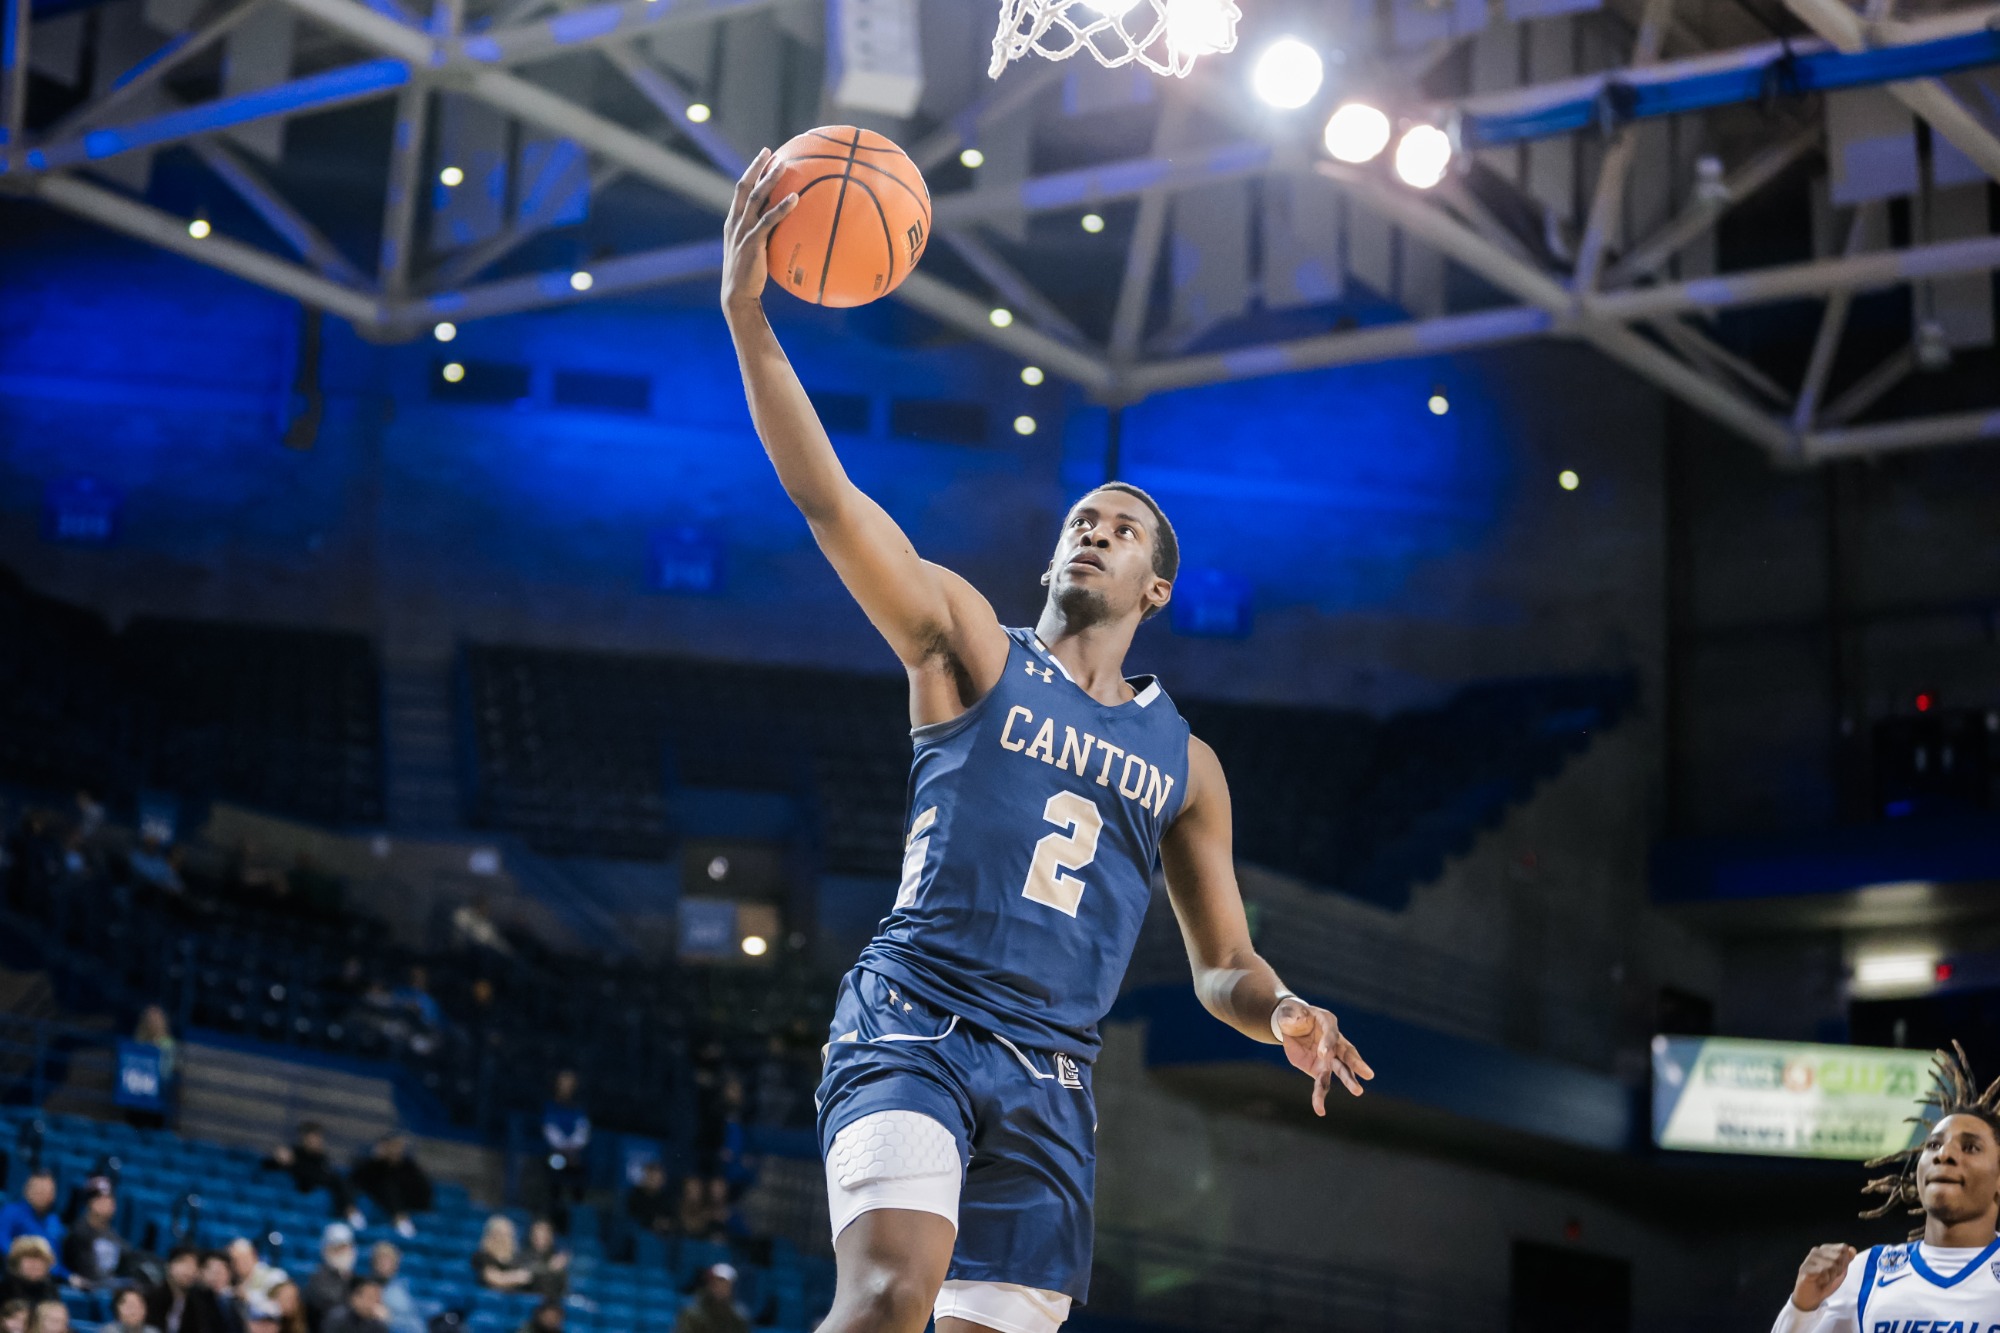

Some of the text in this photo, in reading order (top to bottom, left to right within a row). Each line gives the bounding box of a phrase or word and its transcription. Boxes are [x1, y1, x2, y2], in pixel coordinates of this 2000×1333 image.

[1000, 705, 1174, 818] CANTON
[1021, 790, 1104, 918] 2
[1716, 1121, 1786, 1145] News
